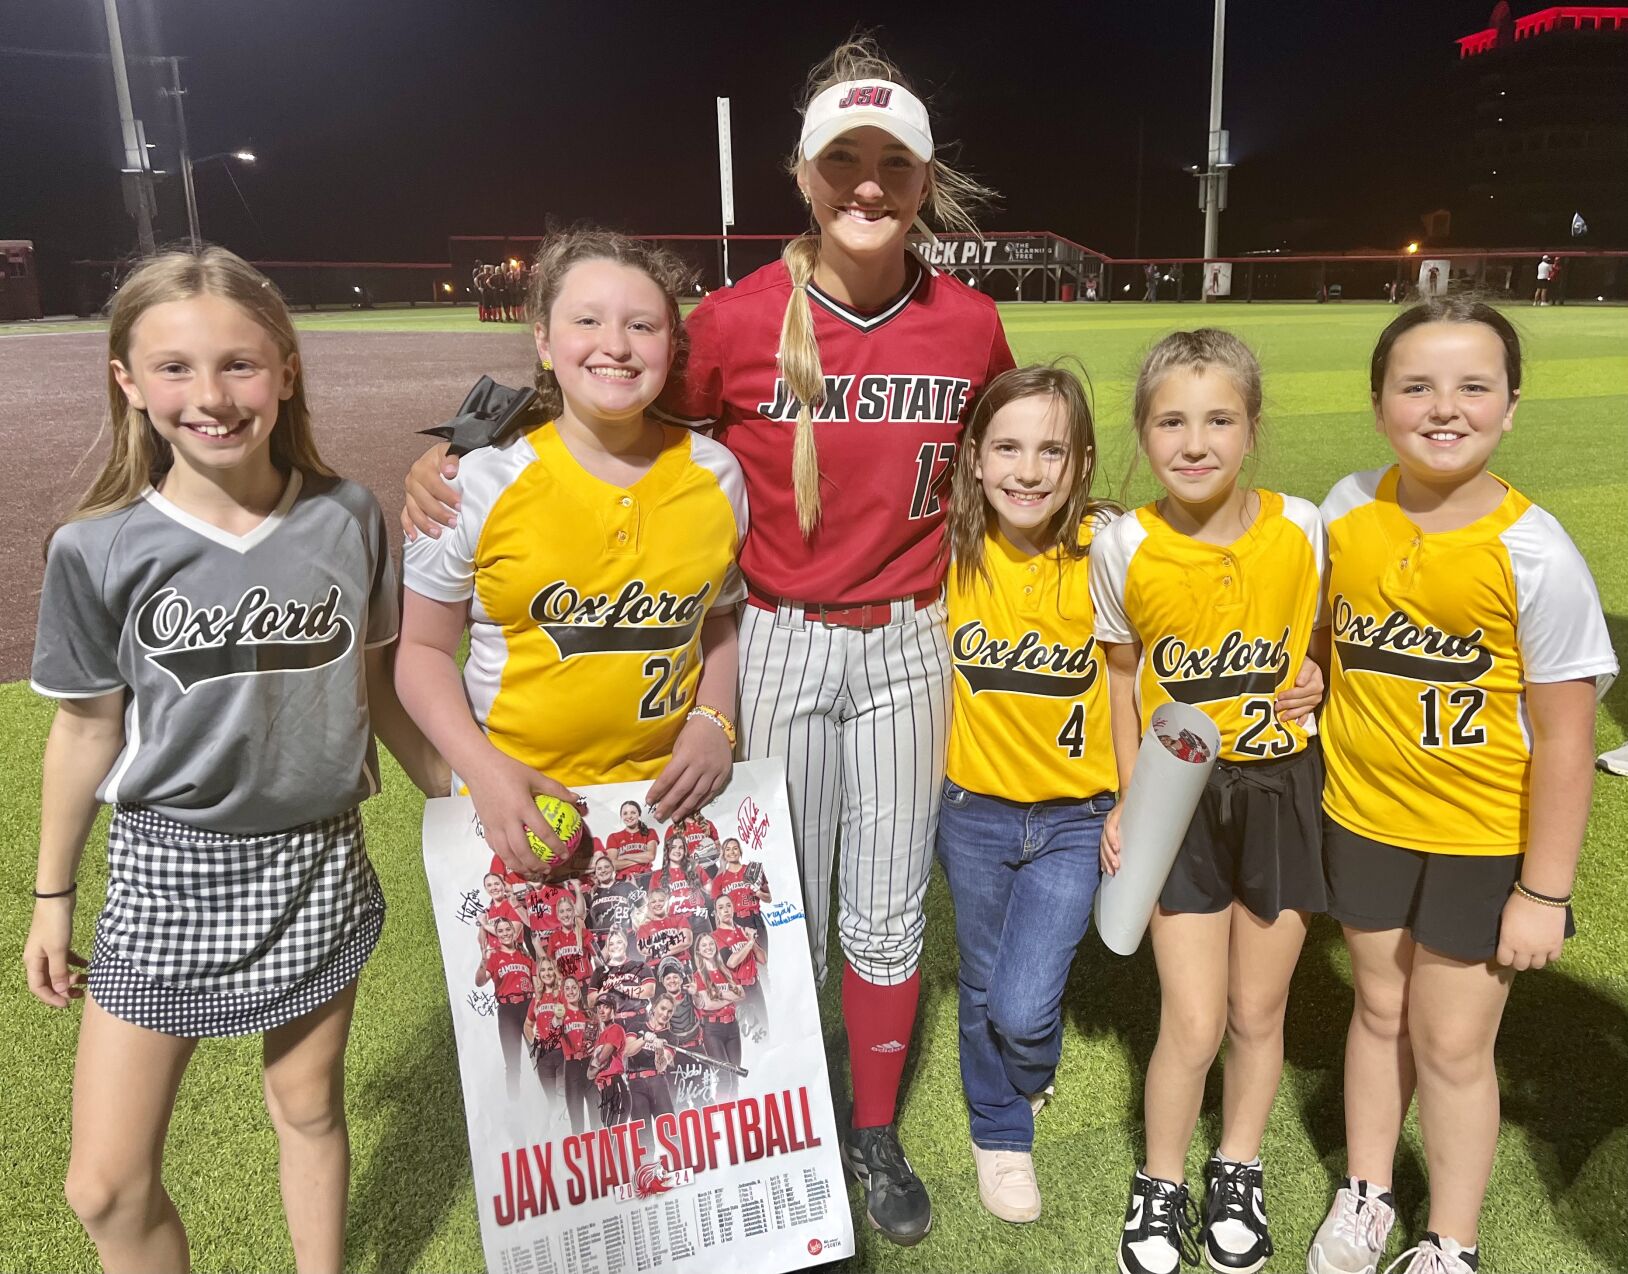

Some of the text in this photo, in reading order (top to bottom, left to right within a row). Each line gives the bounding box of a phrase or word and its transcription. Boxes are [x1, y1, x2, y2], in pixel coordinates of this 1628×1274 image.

[839, 86, 893, 108] JSU
[914, 241, 959, 264] OCK
[855, 374, 971, 424] STATE
[135, 584, 342, 652] Oxford
[529, 579, 711, 627] Oxford
[1332, 592, 1483, 659] Oxford
[952, 619, 1096, 674] Oxford
[1152, 625, 1291, 680] Oxford
[638, 650, 689, 721] 22
[1056, 701, 1086, 759] 4
[1418, 686, 1487, 748] 12
[492, 1141, 561, 1228] JAX
[562, 1118, 648, 1206] STATE
[655, 1086, 822, 1175] SOFTBALL
[619, 1170, 689, 1200] 20 24
